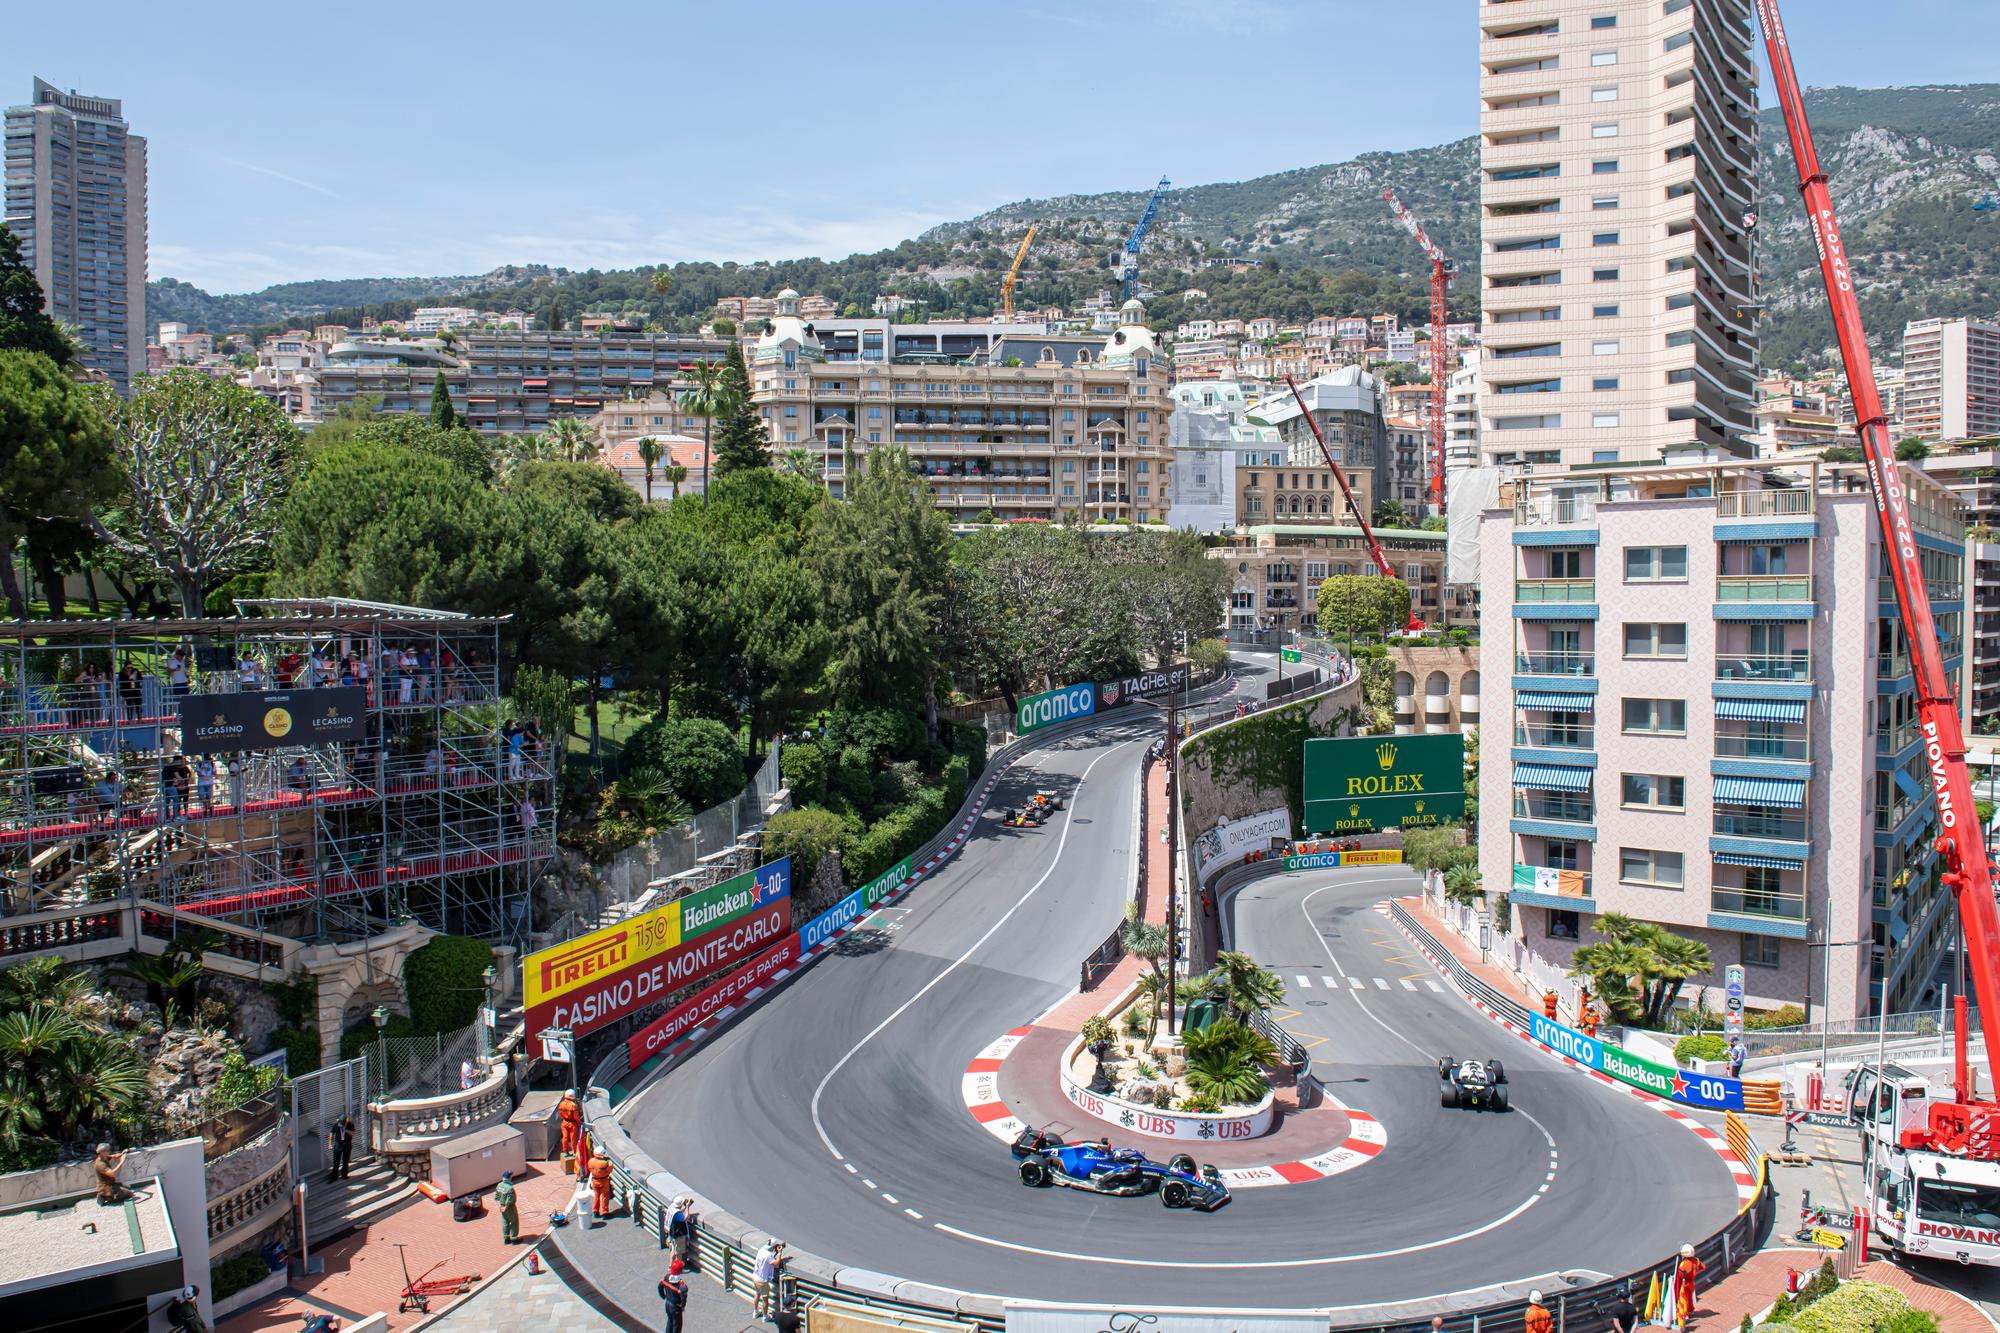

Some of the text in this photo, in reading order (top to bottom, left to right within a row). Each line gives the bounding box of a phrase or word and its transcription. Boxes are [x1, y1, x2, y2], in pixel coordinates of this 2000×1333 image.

[1770, 0, 1786, 45] IOVANO
[1810, 213, 1826, 261] PIOVANO
[1821, 209, 1850, 291] PIOVANO
[1868, 459, 1885, 512] PIOVANO
[1882, 456, 1914, 560] PIOVANO
[321, 716, 353, 726] CASINO
[1021, 688, 1091, 728] aramco
[196, 725, 243, 735] LE CASINO
[1346, 774, 1425, 795] ROLEX
[1922, 723, 1956, 828] PIOVANO
[1335, 818, 1372, 829] ROLEX
[1402, 814, 1437, 824] ROLEX
[1289, 855, 1335, 869] aramco
[1346, 852, 1378, 863] PIRELLI
[868, 864, 907, 903] aramco
[684, 891, 749, 933] Heineken
[808, 900, 857, 945] aramco
[541, 930, 628, 994] PIRELLI
[553, 911, 781, 1031] CASINO DE MONTE-CARLO
[646, 947, 790, 1050] CASINO CAFE DE PARIS
[1535, 1018, 1594, 1064] aramco
[1603, 1051, 1667, 1089] Heineken
[1078, 1091, 1252, 1138] UBS UBS UBS
[1234, 1169, 1272, 1181] UBS
[1326, 1150, 1354, 1164] UBS
[1877, 1214, 1906, 1233] PIOVANO
